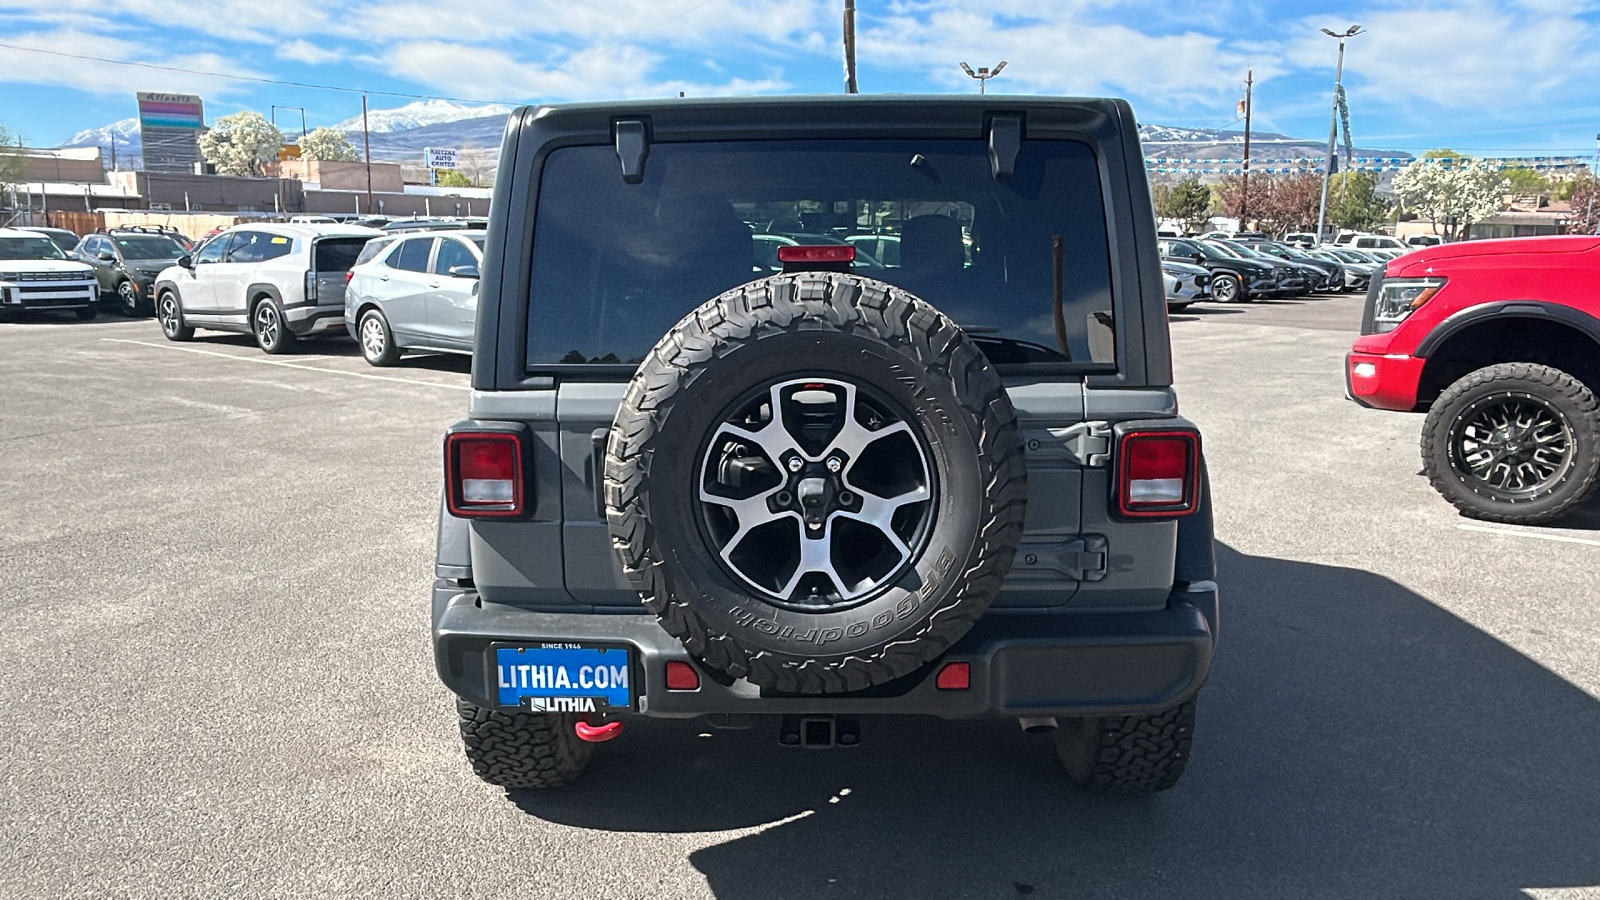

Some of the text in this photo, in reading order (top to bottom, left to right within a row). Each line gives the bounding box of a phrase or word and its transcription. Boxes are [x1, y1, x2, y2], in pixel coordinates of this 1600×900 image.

[729, 546, 956, 645] BFGoodrich
[497, 665, 628, 689] LITHIA.COM
[545, 697, 596, 712] LITHIA
